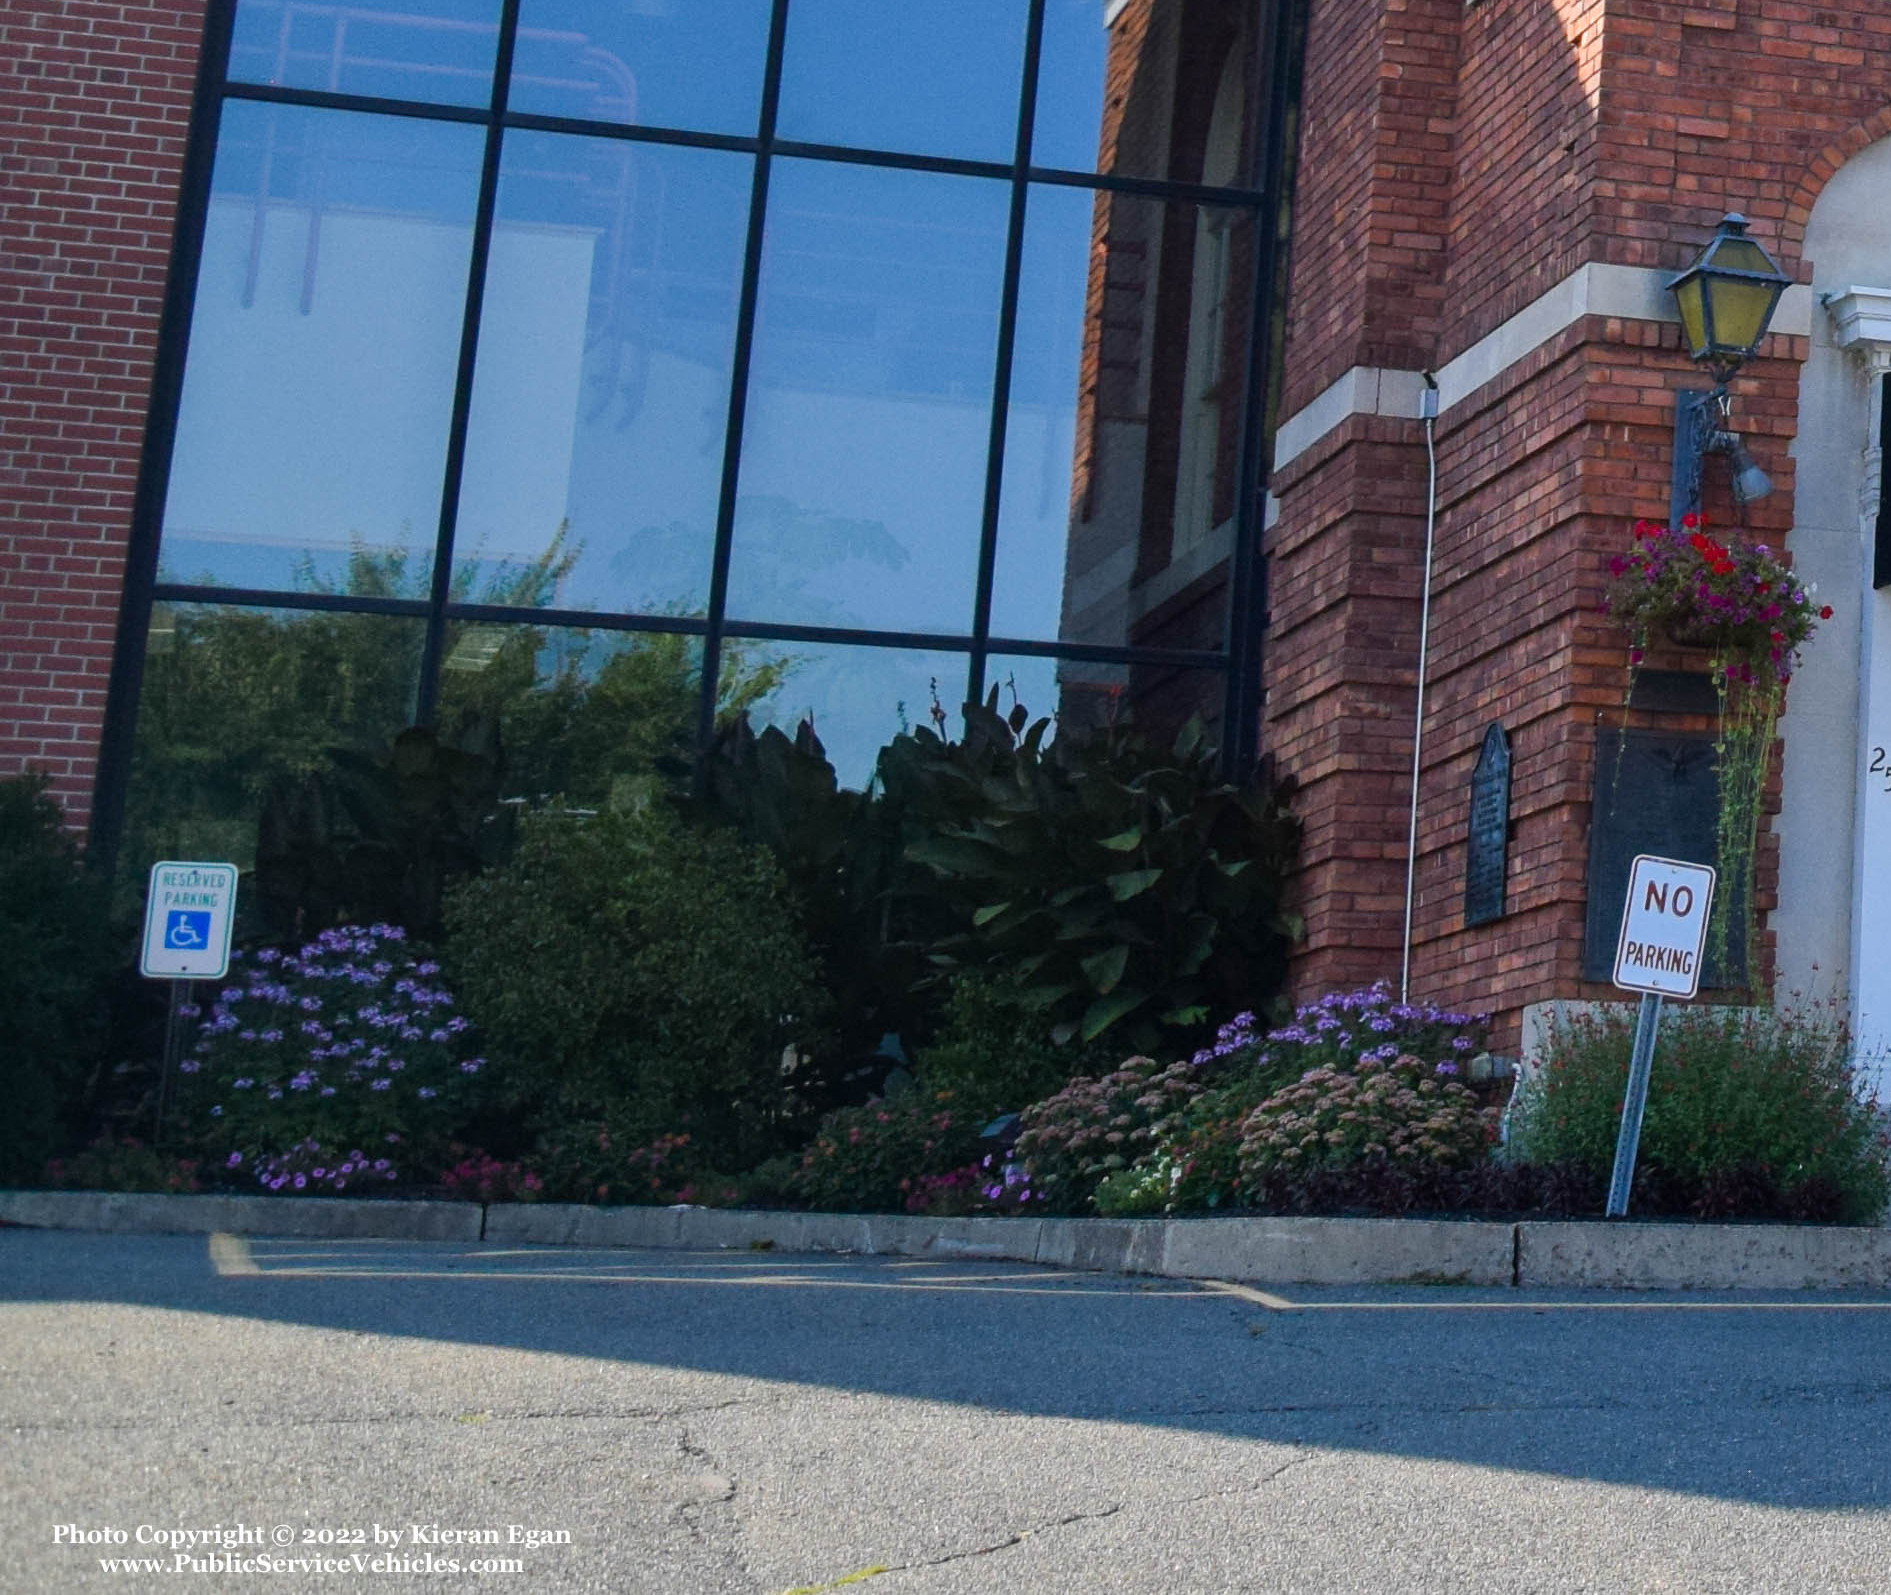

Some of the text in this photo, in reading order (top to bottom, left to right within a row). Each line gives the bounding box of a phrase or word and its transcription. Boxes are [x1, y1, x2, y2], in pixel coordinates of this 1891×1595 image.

[164, 891, 218, 907] PARKING
[1644, 879, 1694, 918] NO
[1625, 940, 1694, 975] PARKING
